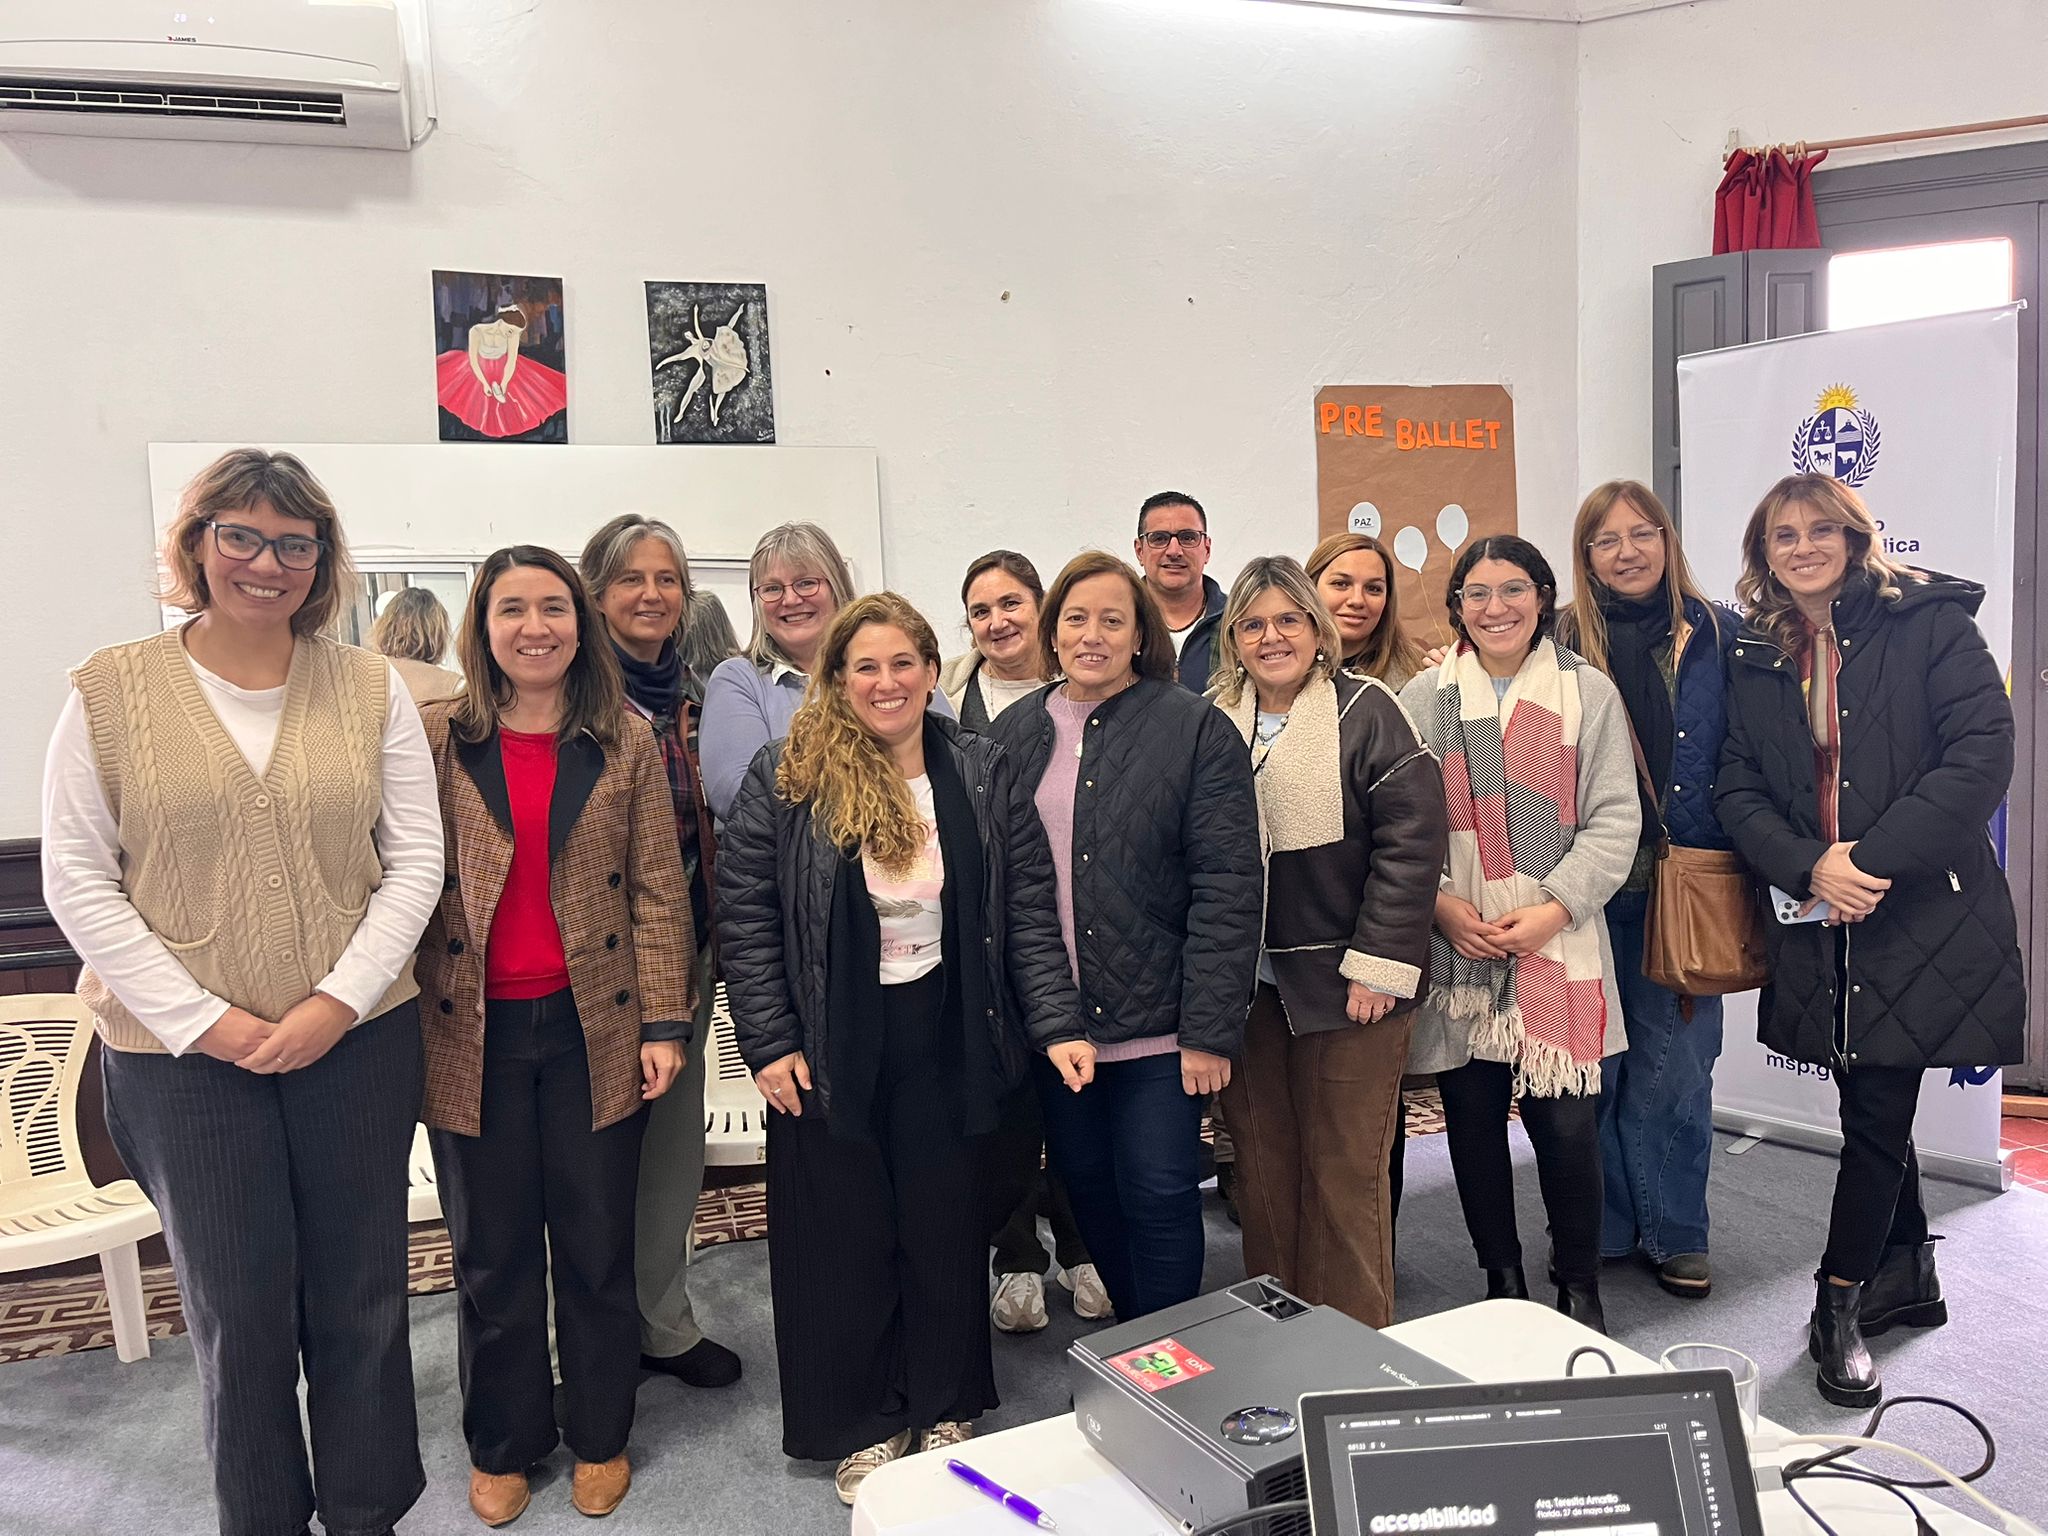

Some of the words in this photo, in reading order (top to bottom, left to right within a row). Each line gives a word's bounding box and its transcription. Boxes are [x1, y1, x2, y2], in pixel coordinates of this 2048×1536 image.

[1320, 402, 1384, 437] PRE
[1396, 418, 1501, 450] BALLET
[1354, 517, 1371, 526] PAZ
[1883, 537, 1920, 554] lica
[1767, 1052, 1830, 1081] msp.g
[1369, 1503, 1496, 1534] accesibilidad
[1583, 1507, 1602, 1516] mayo
